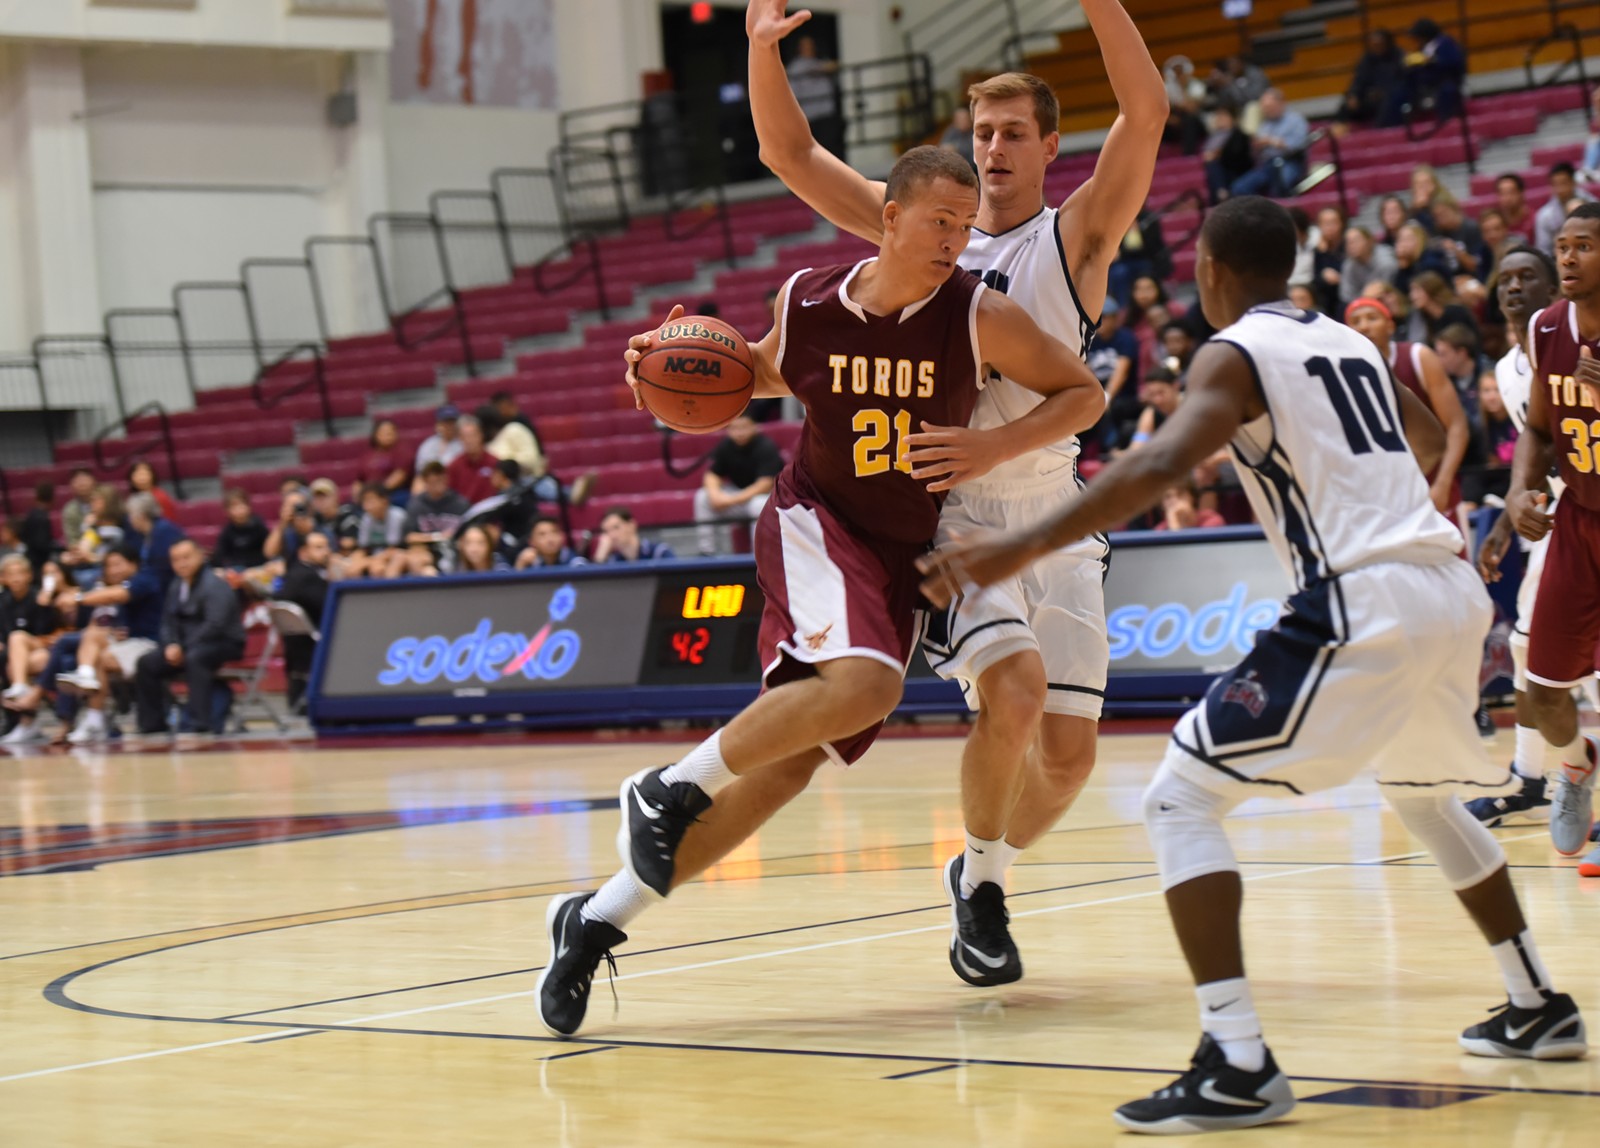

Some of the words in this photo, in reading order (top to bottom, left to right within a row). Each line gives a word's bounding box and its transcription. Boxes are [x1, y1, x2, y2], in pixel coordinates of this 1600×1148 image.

[659, 322, 737, 353] Wilson
[663, 356, 722, 378] NCAA
[828, 354, 935, 398] TOROS
[1303, 355, 1408, 456] 10
[852, 408, 914, 477] 21
[681, 584, 746, 619] LMU
[378, 617, 581, 685] sodexo
[672, 627, 711, 665] 42
